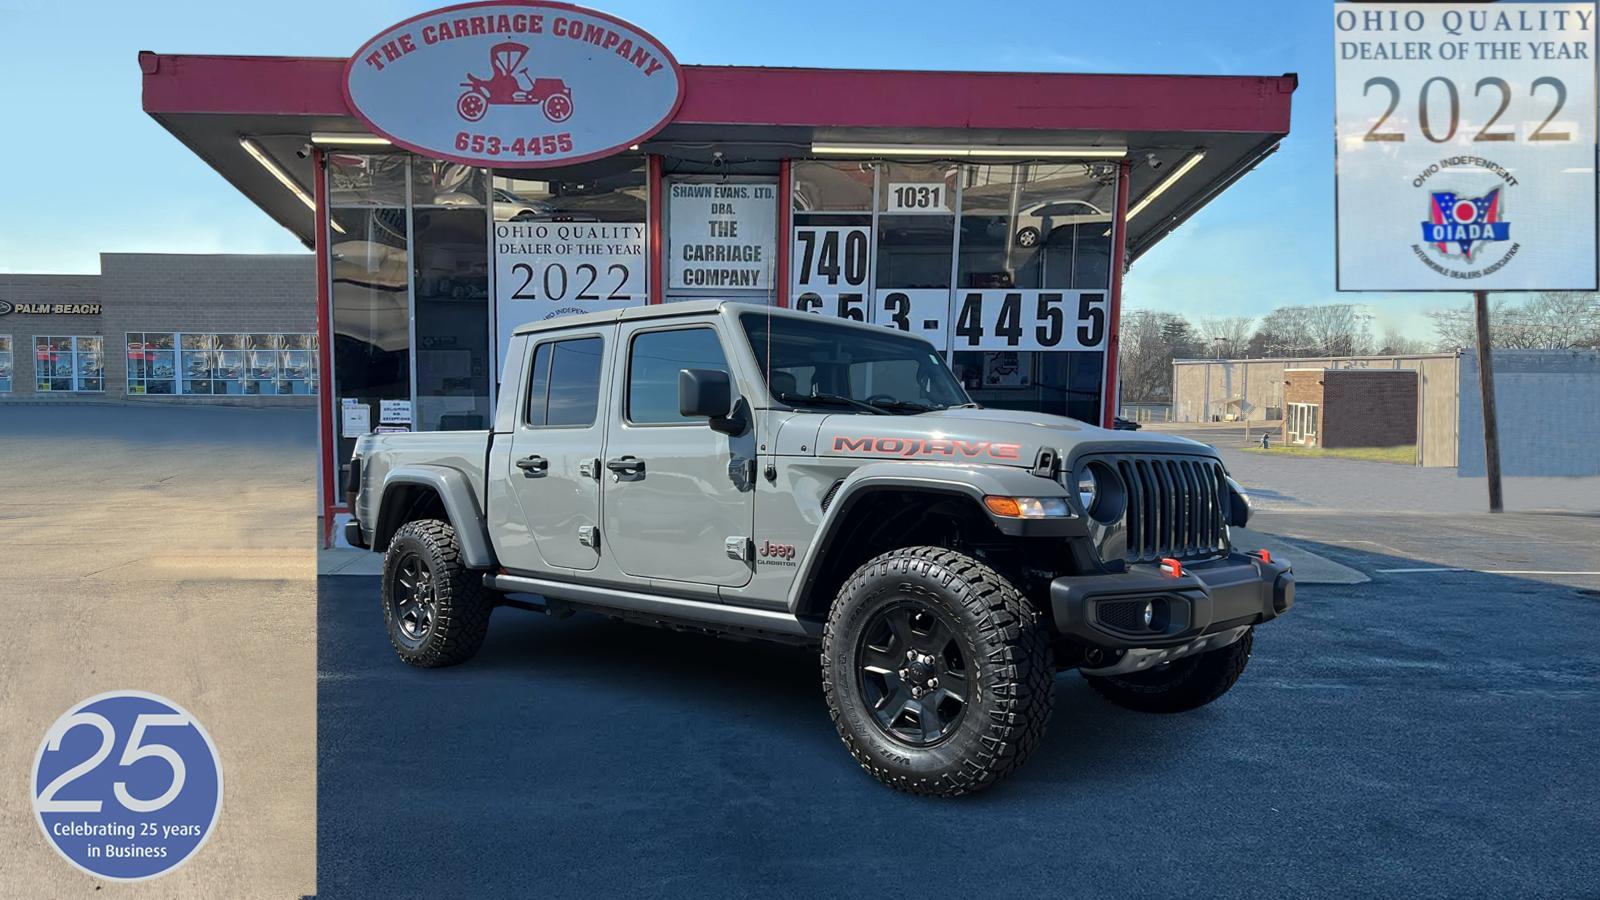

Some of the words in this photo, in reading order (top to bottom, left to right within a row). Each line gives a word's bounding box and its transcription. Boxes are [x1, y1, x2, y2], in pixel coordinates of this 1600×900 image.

[1336, 10, 1425, 31] OHIO
[1442, 10, 1593, 35] QUALITY
[365, 33, 417, 72] THE
[422, 14, 544, 45] CARRIAGE
[552, 17, 664, 78] COMPANY
[1340, 42, 1433, 60] DEALER
[1439, 42, 1469, 60] OF
[1475, 42, 1521, 60] THE
[1528, 42, 1589, 60] YEAR
[1363, 76, 1570, 143] 2022
[455, 132, 572, 156] 653-4455
[1413, 164, 1439, 188] OHIO
[1440, 156, 1519, 187] INDEPENDENT
[672, 186, 712, 198] SHAWN
[754, 187, 774, 199] LTD.
[895, 187, 940, 208] 1031
[711, 203, 736, 215] DBA.
[497, 226, 548, 239] OHIO
[557, 226, 644, 241] QUALITY
[708, 221, 738, 238] THE
[1433, 224, 1495, 240] OIADA
[500, 243, 552, 255] DEALER
[555, 243, 573, 255] OF
[576, 243, 603, 255] THE
[605, 243, 641, 255] YEAR
[683, 244, 762, 262] CARRIAGE
[797, 230, 868, 286] 740
[1411, 244, 1450, 277] AUTOMOBILE
[1449, 270, 1482, 280] DEALERS
[1482, 242, 1520, 276] ASSOCIATION
[511, 263, 632, 301] 2022
[683, 268, 760, 287] COMPANY
[15, 304, 51, 314] PALM
[54, 304, 100, 314] BEACH
[833, 436, 1021, 460] MOJAVE
[760, 539, 796, 561] Jeep
